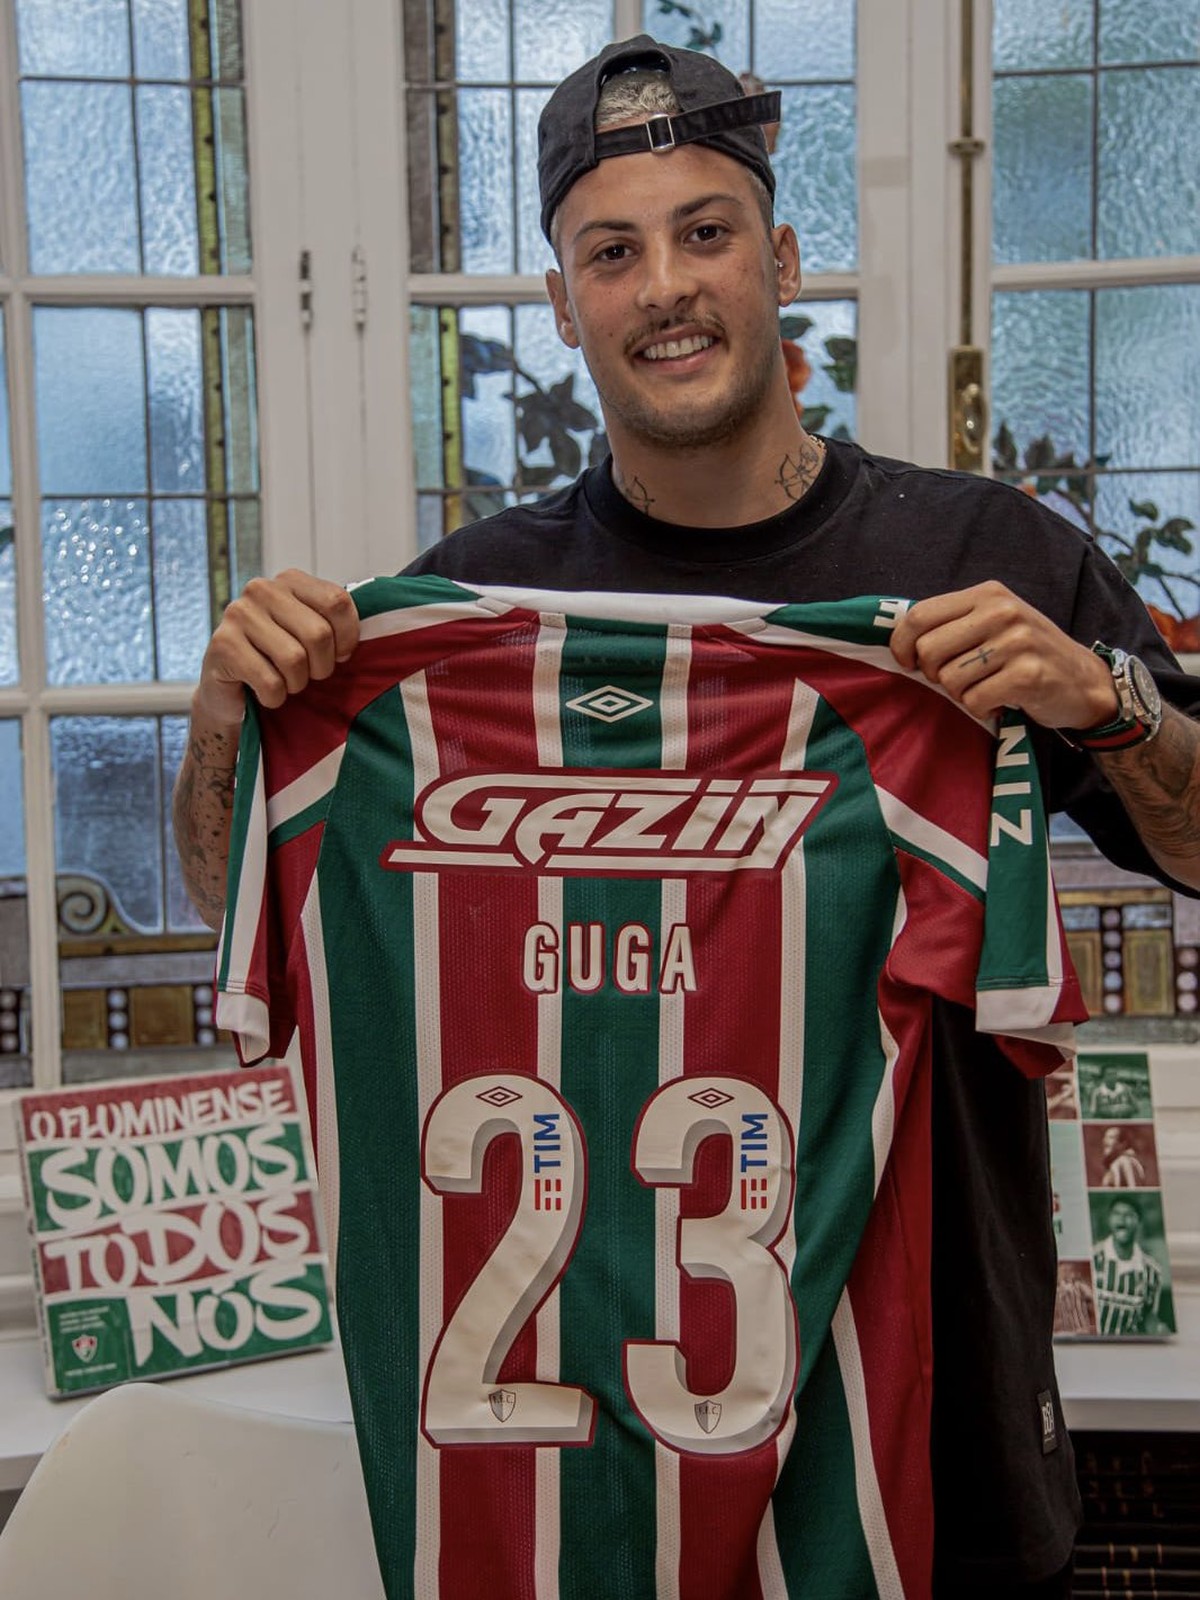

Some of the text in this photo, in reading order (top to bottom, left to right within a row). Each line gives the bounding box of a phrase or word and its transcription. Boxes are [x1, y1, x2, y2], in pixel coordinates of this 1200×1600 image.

[385, 770, 834, 874] GAZIN
[523, 922, 698, 993] GUGA
[30, 1080, 291, 1141] O FLUMINENSE
[533, 1113, 561, 1174] TIM
[740, 1113, 769, 1173] TIM
[40, 1121, 298, 1230] SOMOS
[44, 1192, 311, 1290] TODOS
[421, 1073, 799, 1454] 23
